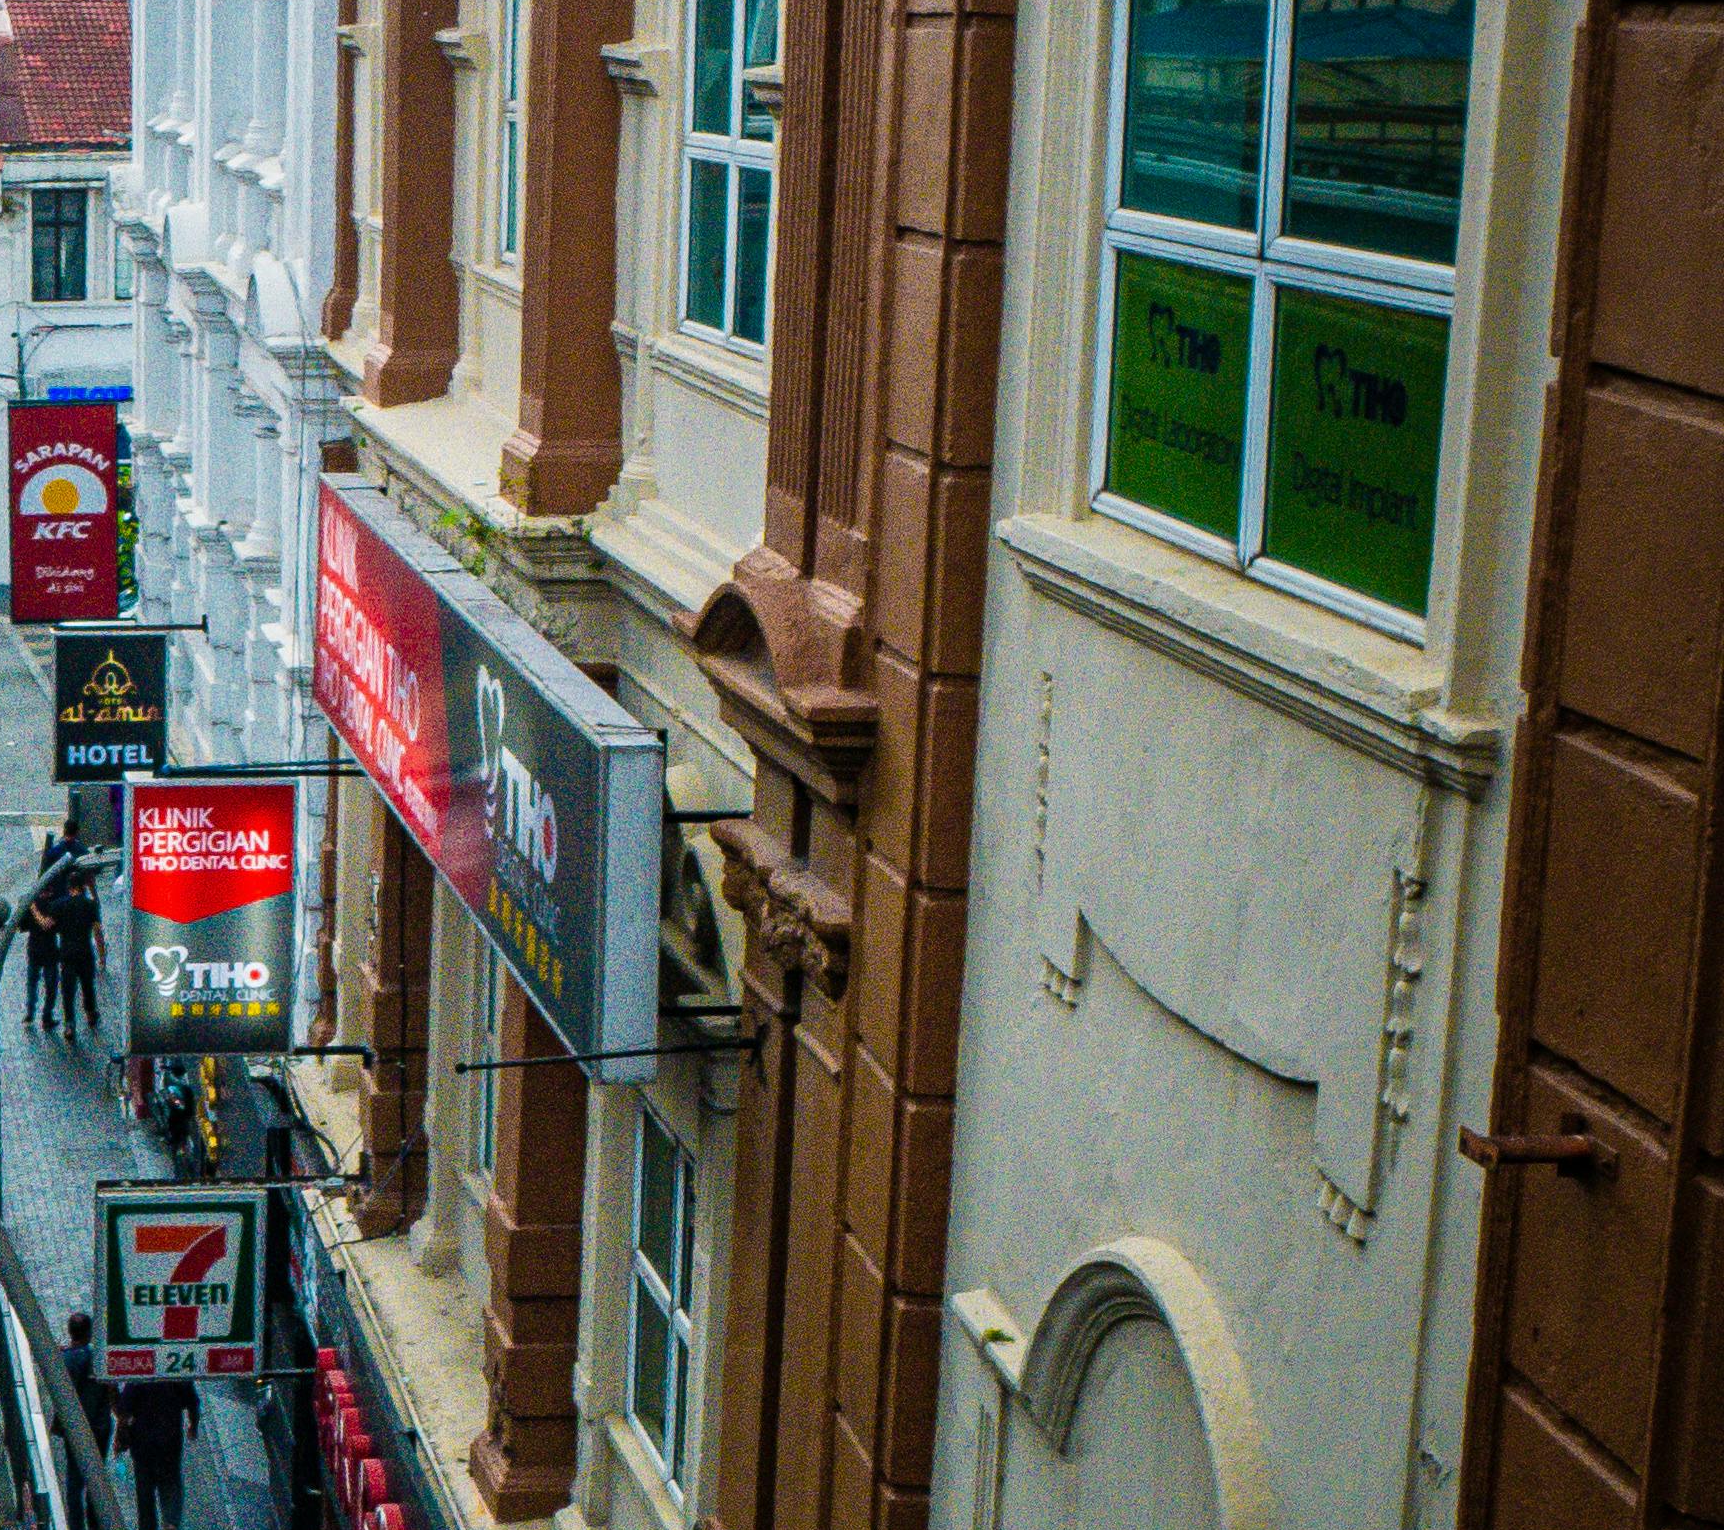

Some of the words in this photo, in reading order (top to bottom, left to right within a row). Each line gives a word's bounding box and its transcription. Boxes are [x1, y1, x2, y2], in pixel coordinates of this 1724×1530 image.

[13, 442, 112, 473] SARAPAN
[32, 521, 92, 541] KFC
[67, 744, 154, 766] HOTEL
[138, 807, 214, 829] KLINIK
[501, 745, 558, 884] TIHO
[138, 829, 270, 853] PERGIGIAN
[140, 855, 178, 872] TIHO
[179, 854, 238, 871] DENTAL
[240, 853, 289, 871] CLINIC
[185, 961, 271, 989] TIHO
[179, 990, 230, 1003] DENTAL
[235, 989, 277, 1002] CLINIC
[135, 1225, 227, 1340] 7
[166, 1351, 196, 1373] 24
